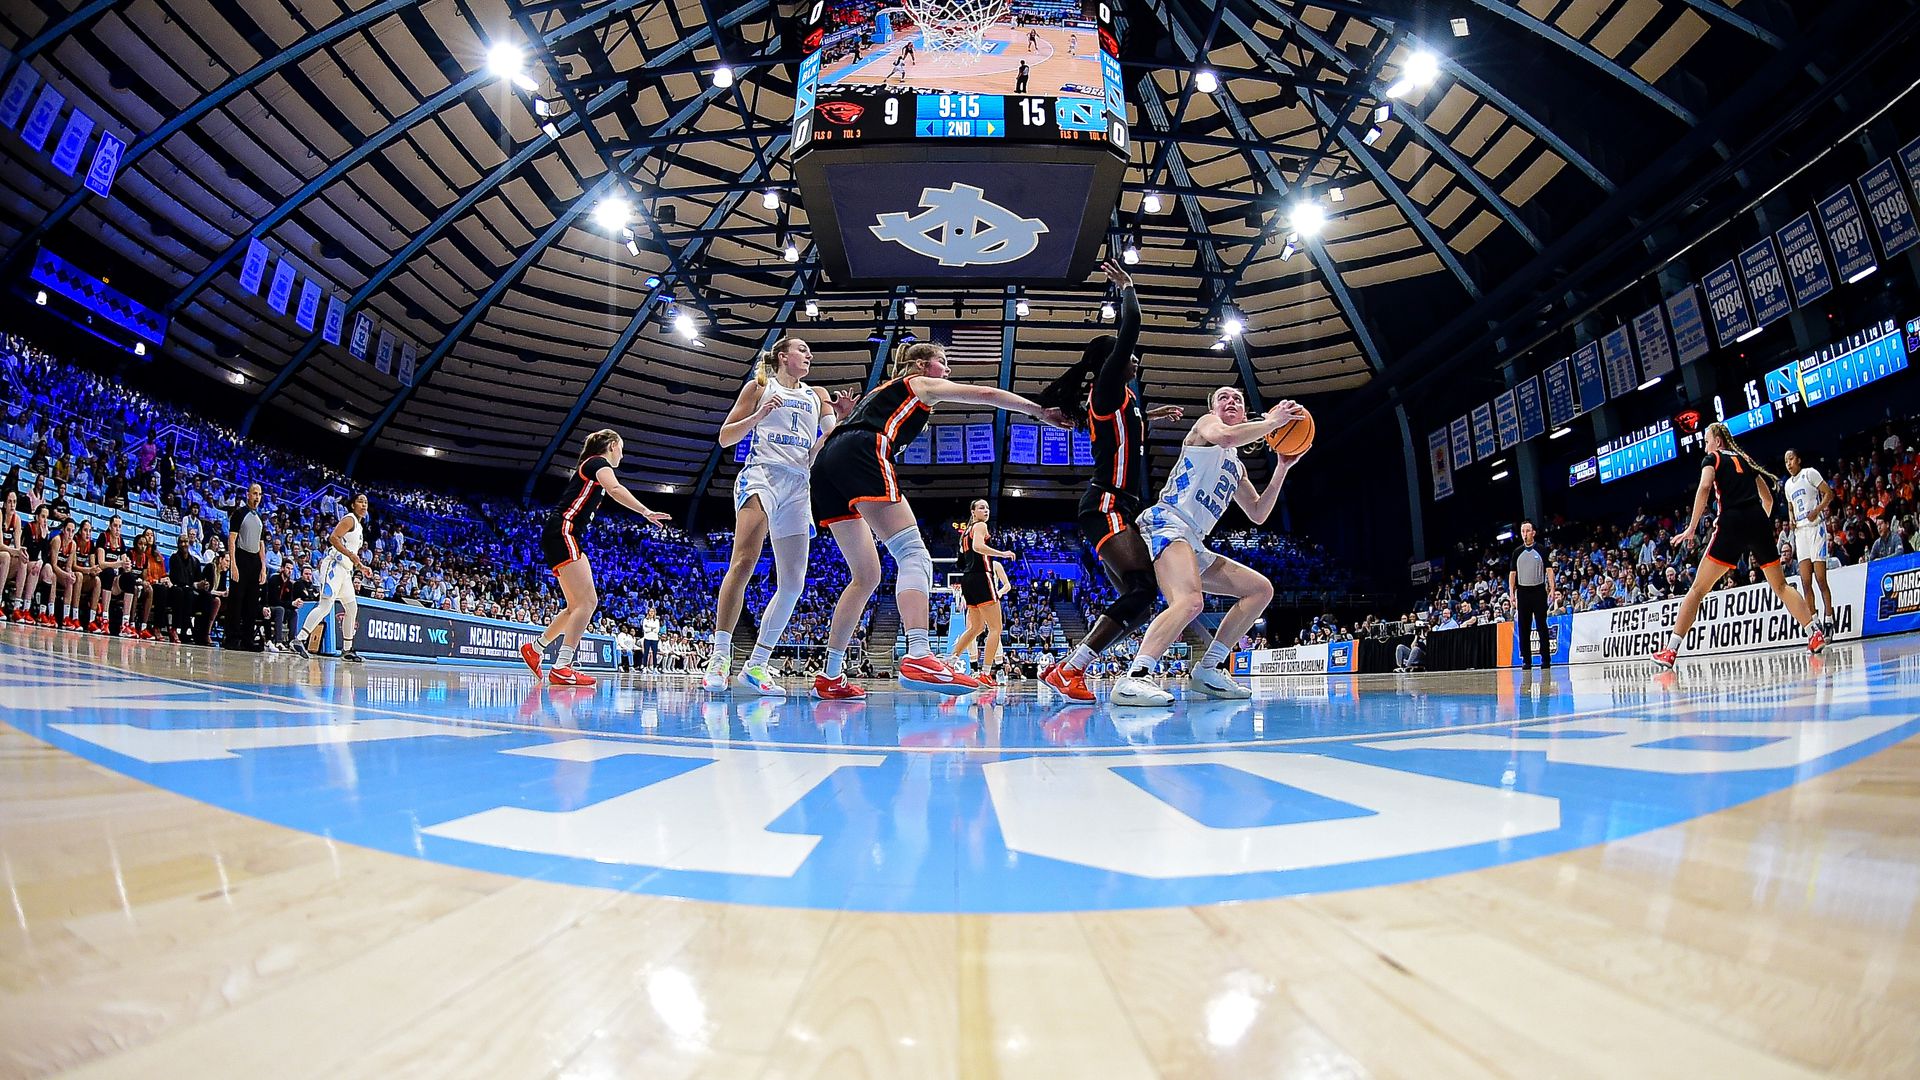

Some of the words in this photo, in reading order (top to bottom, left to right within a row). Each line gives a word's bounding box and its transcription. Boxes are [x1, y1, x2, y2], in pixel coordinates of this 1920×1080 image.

[810, 0, 824, 25] 0
[1100, 2, 1110, 24] 0
[801, 63, 818, 83] BLK
[1103, 53, 1120, 71] TEAM
[1105, 66, 1120, 84] BLK
[885, 98, 899, 125] 9
[939, 95, 980, 118] 9:15
[1019, 98, 1046, 126] 15
[794, 119, 809, 149] 0
[814, 131, 825, 140] FLS
[827, 131, 832, 140] 0
[843, 130, 854, 139] TOL
[856, 129, 861, 138] 3
[948, 121, 971, 136] 2ND
[1060, 131, 1072, 139] FLS
[1090, 132, 1100, 140] TOL
[1102, 131, 1107, 140] 4
[1113, 121, 1125, 148] 0
[1873, 191, 1908, 228] 1998
[1831, 218, 1863, 252] 1997
[1788, 243, 1822, 277] 1995
[1749, 267, 1782, 299] 1994
[1712, 290, 1742, 320] 1984
[1885, 319, 1894, 333] 20
[1743, 379, 1760, 410] 15
[1714, 395, 1724, 422] 9
[1747, 411, 1764, 428] 9:15
[791, 412, 798, 432] 1
[1894, 571, 1920, 592] MARC
[1611, 607, 1648, 633] FIRST
[1661, 596, 1719, 627] SEND
[368, 619, 407, 641] OREGON
[409, 625, 422, 643] ST.
[470, 627, 492, 647] NCAA
[494, 629, 517, 649] FIRST
[1576, 645, 1592, 653] HOSTED
[1593, 644, 1600, 652] BY
[1603, 630, 1680, 657] UNIVERSIT
[1687, 626, 1706, 650] OF
[1709, 617, 1762, 649] NORTH
[1768, 604, 1851, 642] CARNA
